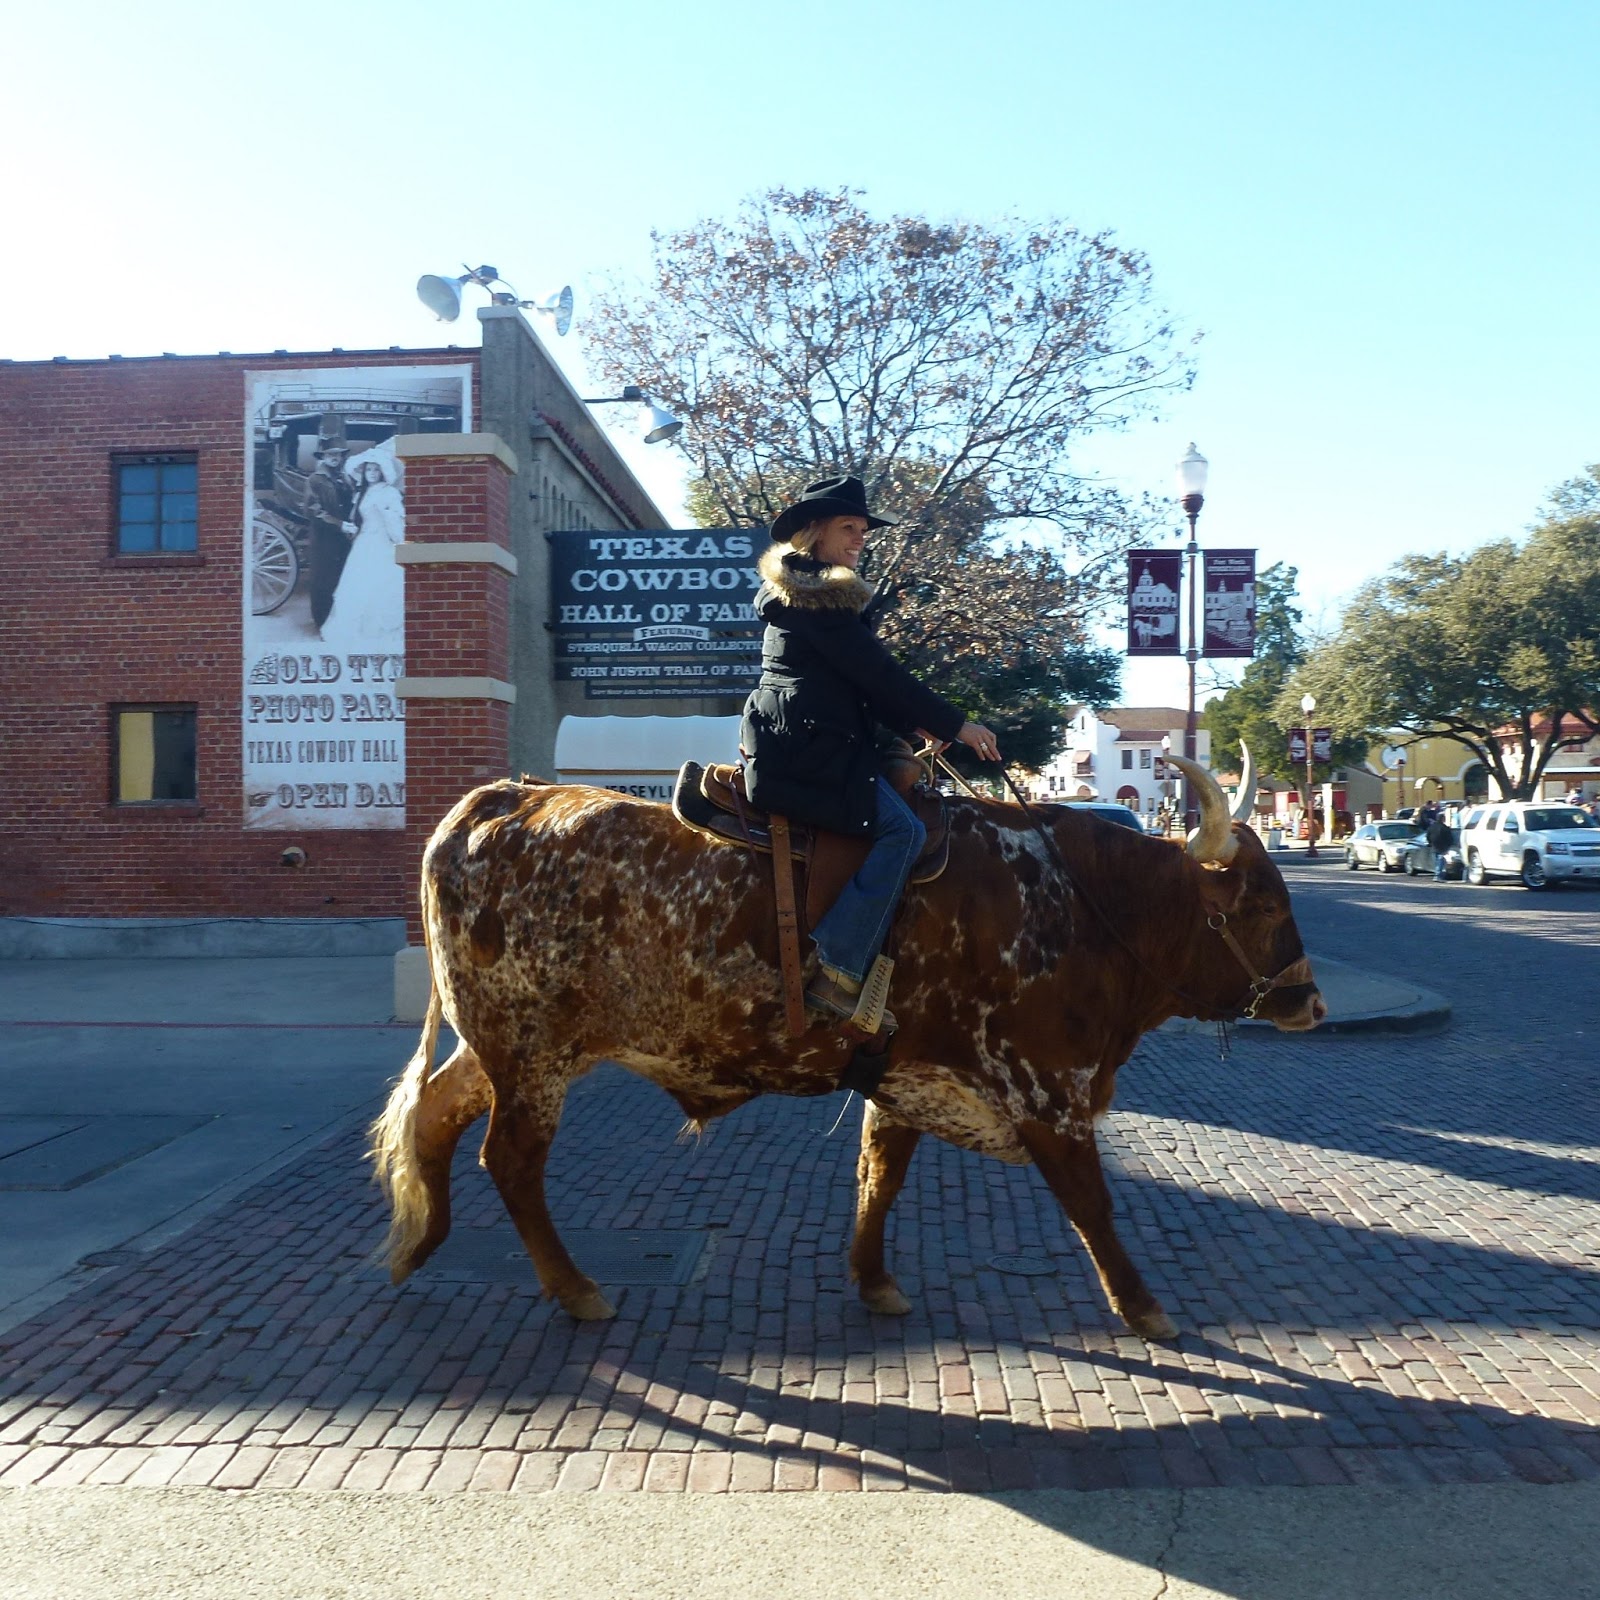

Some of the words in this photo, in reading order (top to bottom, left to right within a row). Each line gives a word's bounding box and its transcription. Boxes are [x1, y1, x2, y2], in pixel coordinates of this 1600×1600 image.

[589, 536, 753, 561] TEXAS
[570, 567, 764, 592] COWBOY
[560, 604, 642, 624] HALL
[650, 604, 691, 623] OF
[698, 603, 760, 622] FAM
[641, 627, 704, 638] FEATURING
[567, 642, 644, 654] STERQUELL
[644, 642, 694, 652] WAGON
[696, 640, 764, 651] COLLECTIO
[280, 654, 342, 684] OLD
[347, 654, 405, 683] TYM
[570, 666, 609, 677] JOHN
[610, 666, 662, 677] JUSTIN
[663, 665, 708, 676] TRAIL
[710, 665, 730, 675] OF
[732, 664, 764, 675] FAM
[248, 694, 335, 723] PHOTO
[247, 740, 293, 764] TEXAS
[298, 740, 357, 763] COWBOY
[362, 739, 399, 763] HALL
[277, 783, 349, 809] OPEN
[354, 782, 406, 808] DAI
